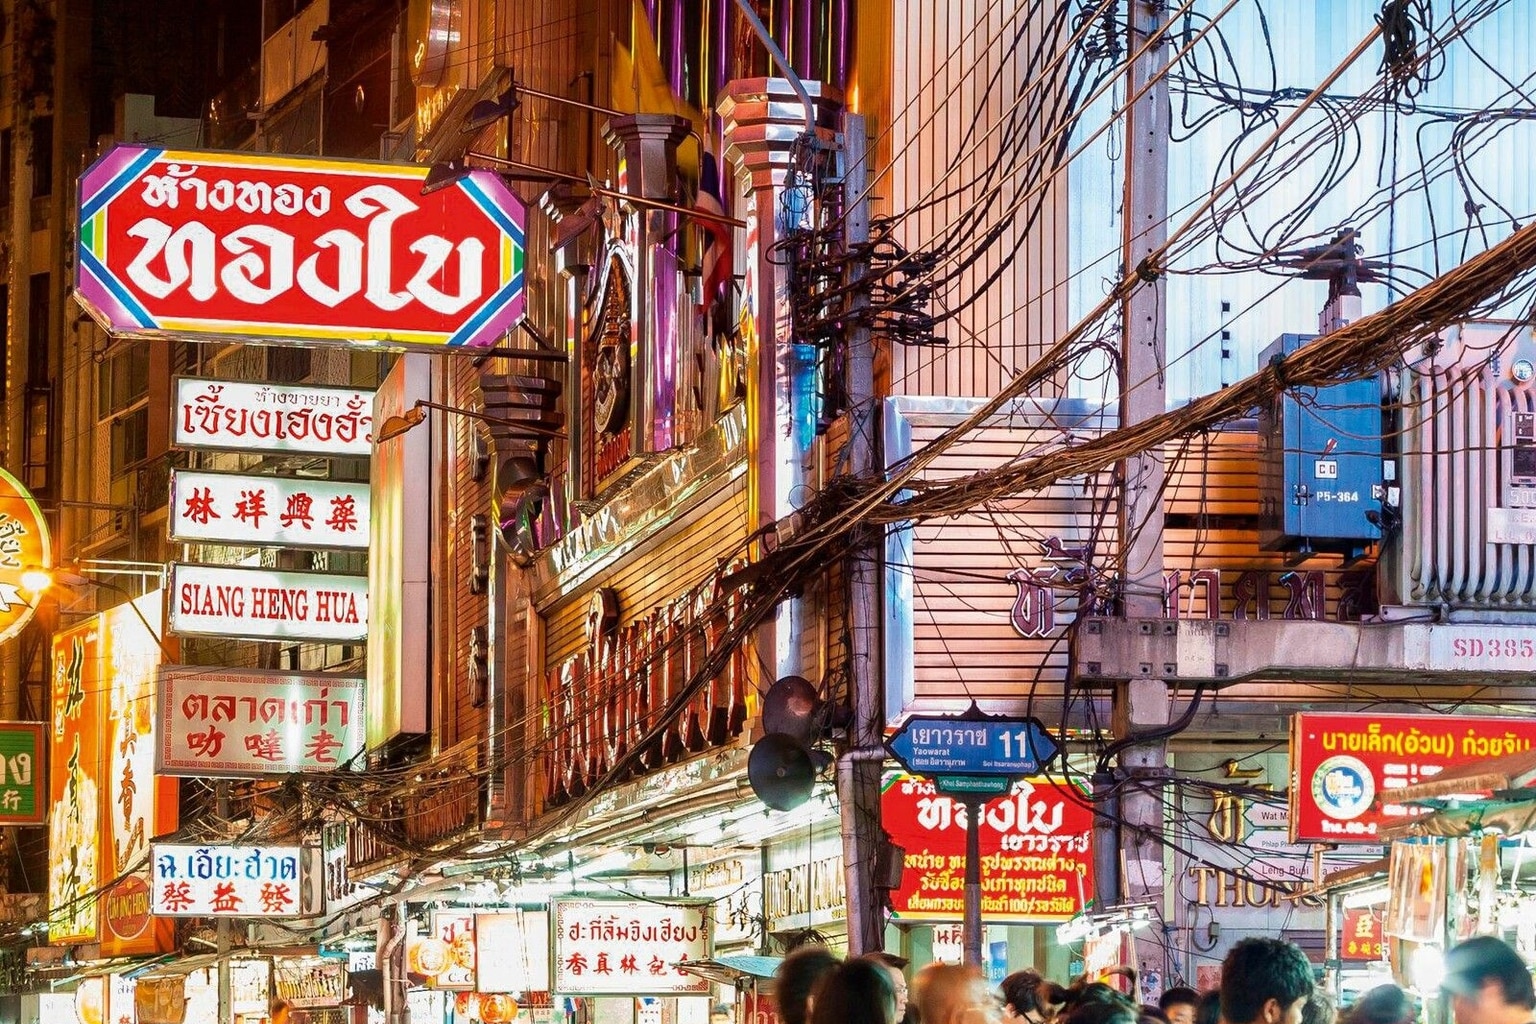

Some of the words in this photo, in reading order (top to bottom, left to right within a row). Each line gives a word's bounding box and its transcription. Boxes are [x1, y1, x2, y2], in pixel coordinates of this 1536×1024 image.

[141, 164, 332, 217] ห้างทอง
[125, 184, 486, 315] ทองใบ
[183, 488, 358, 533] 林祥興藥
[181, 583, 245, 618] SIANG
[251, 588, 309, 621] HENG
[316, 591, 359, 624] HUA
[182, 687, 350, 728] ตลาดเก่า
[912, 728, 987, 746] เยาวราช
[999, 731, 1026, 758] 11
[913, 748, 950, 756] Yaowarat
[1261, 812, 1277, 821] Wat
[1261, 865, 1284, 877] Leng
[1289, 865, 1309, 875] Buai
[161, 881, 294, 914] 蔡益發
